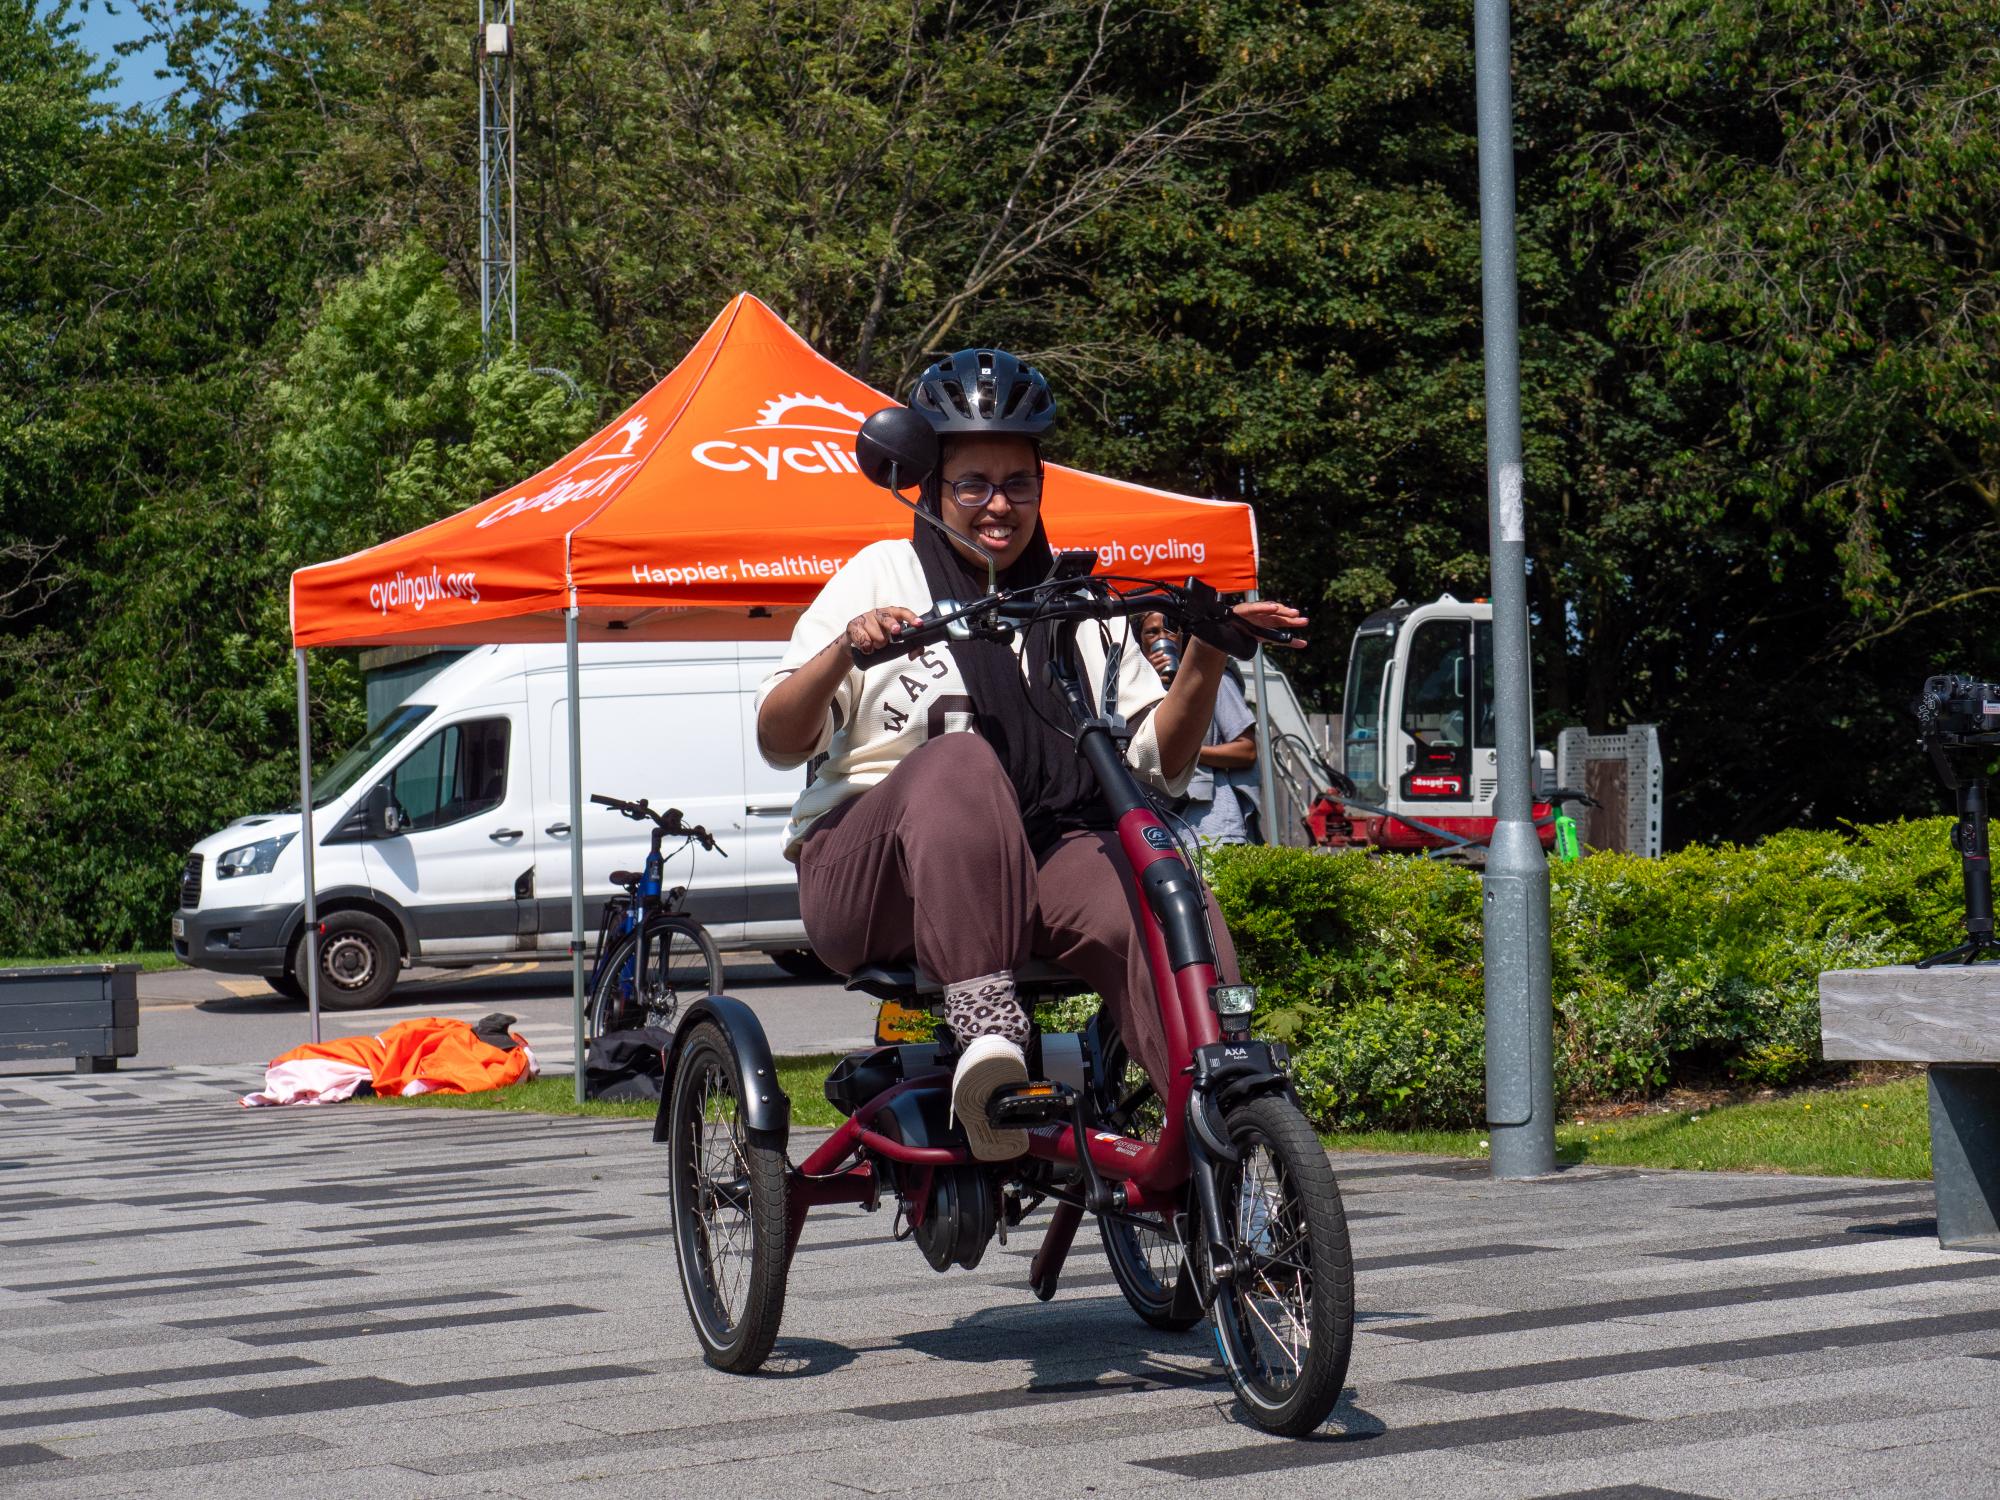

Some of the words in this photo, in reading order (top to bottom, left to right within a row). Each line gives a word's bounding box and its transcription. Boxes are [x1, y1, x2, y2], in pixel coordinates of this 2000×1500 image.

[691, 440, 859, 481] Cycli
[632, 560, 737, 586] Happier,
[739, 555, 842, 578] healthier
[1129, 538, 1206, 565] cycling
[369, 565, 480, 616] cyclinguk.org
[1225, 1048, 1247, 1056] AXA
